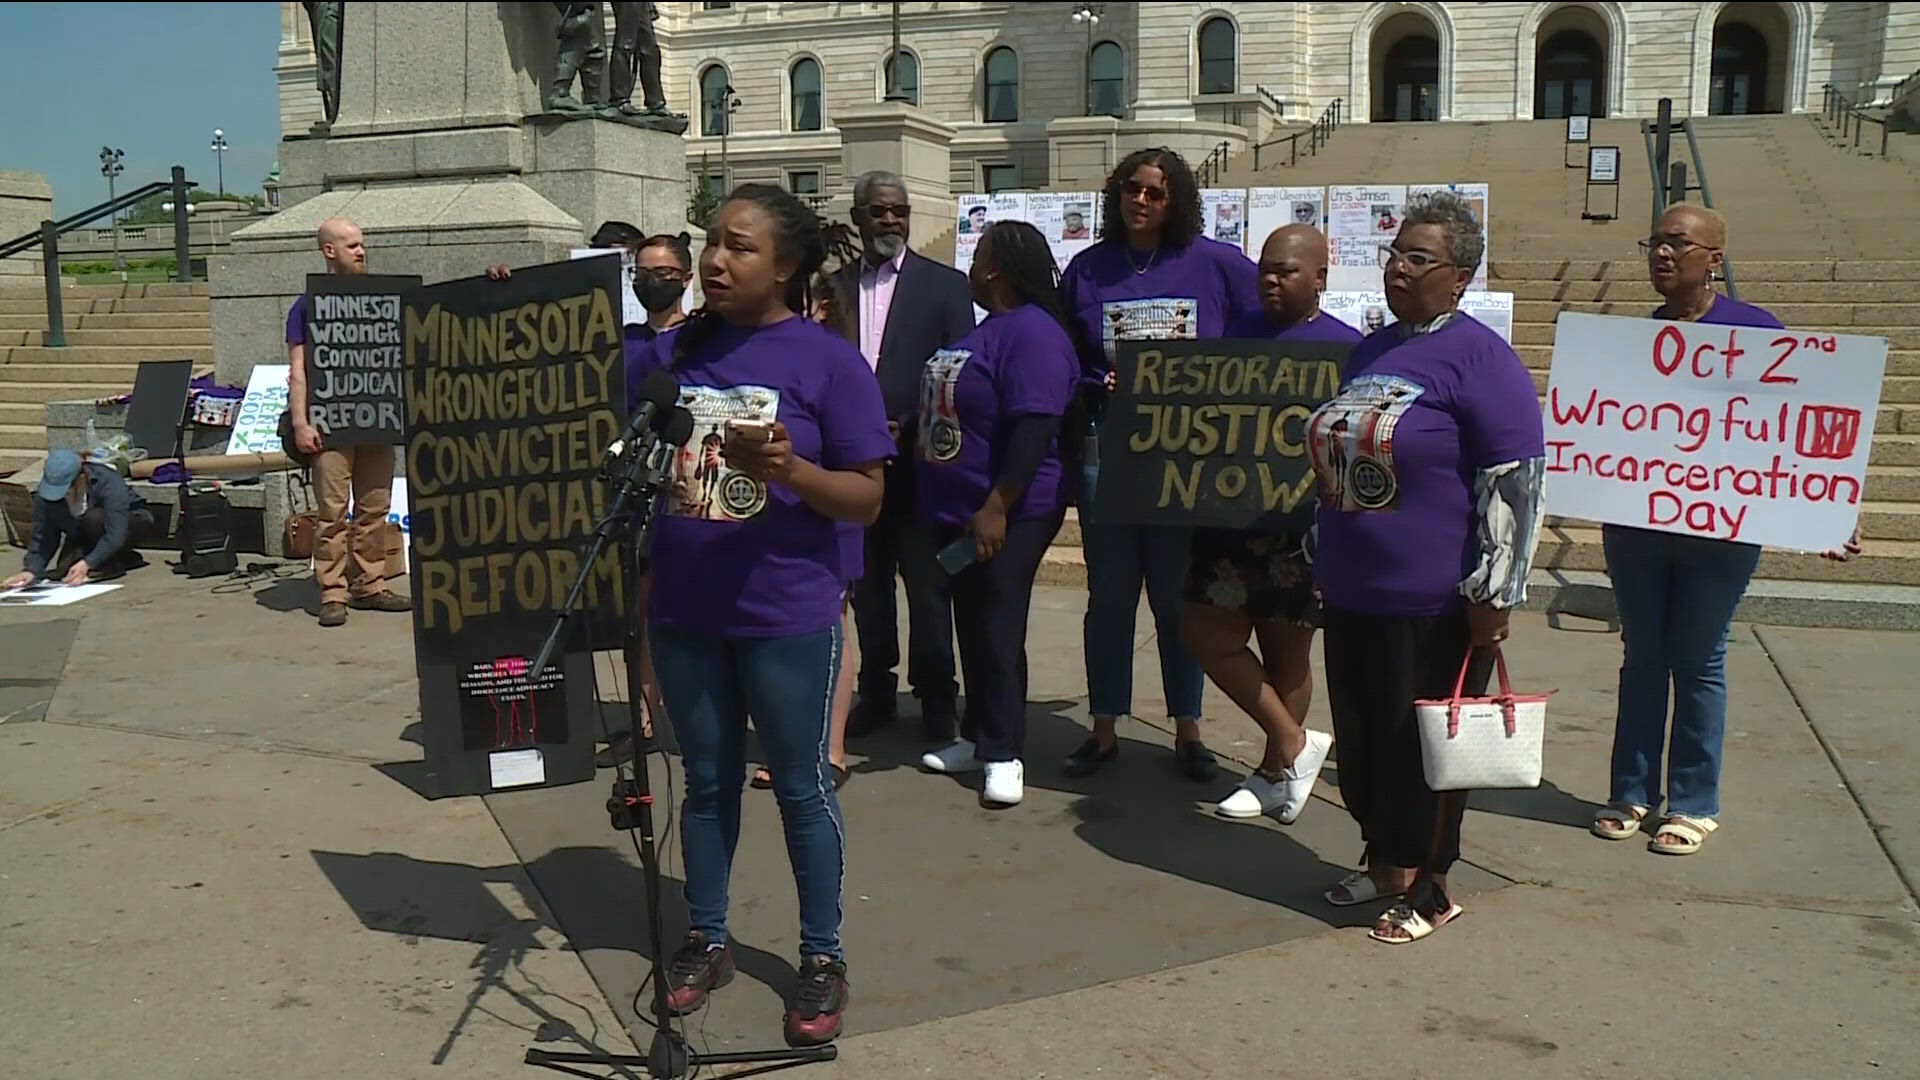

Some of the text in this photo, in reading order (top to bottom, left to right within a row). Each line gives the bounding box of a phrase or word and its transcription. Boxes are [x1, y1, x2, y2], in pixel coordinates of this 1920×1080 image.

[1330, 187, 1353, 202] Chris
[1355, 187, 1390, 202] Johnson
[314, 294, 400, 321] MINNESOT
[405, 287, 618, 367] MINNESOTA
[313, 345, 401, 368] CONVICTE
[1132, 349, 1340, 400] RESTORATI
[1652, 325, 1836, 384] Oct 2nd
[405, 349, 620, 425] WRONGFULLY
[309, 402, 404, 435] REFOR
[1129, 404, 1311, 457] JUSTIC
[1551, 386, 1788, 452] Wrongful
[406, 409, 620, 495] CONVICTED
[1546, 440, 1860, 504] Incarceration
[1157, 459, 1317, 514] NOW
[1649, 490, 1748, 540] Day
[421, 542, 625, 634] REFORM
